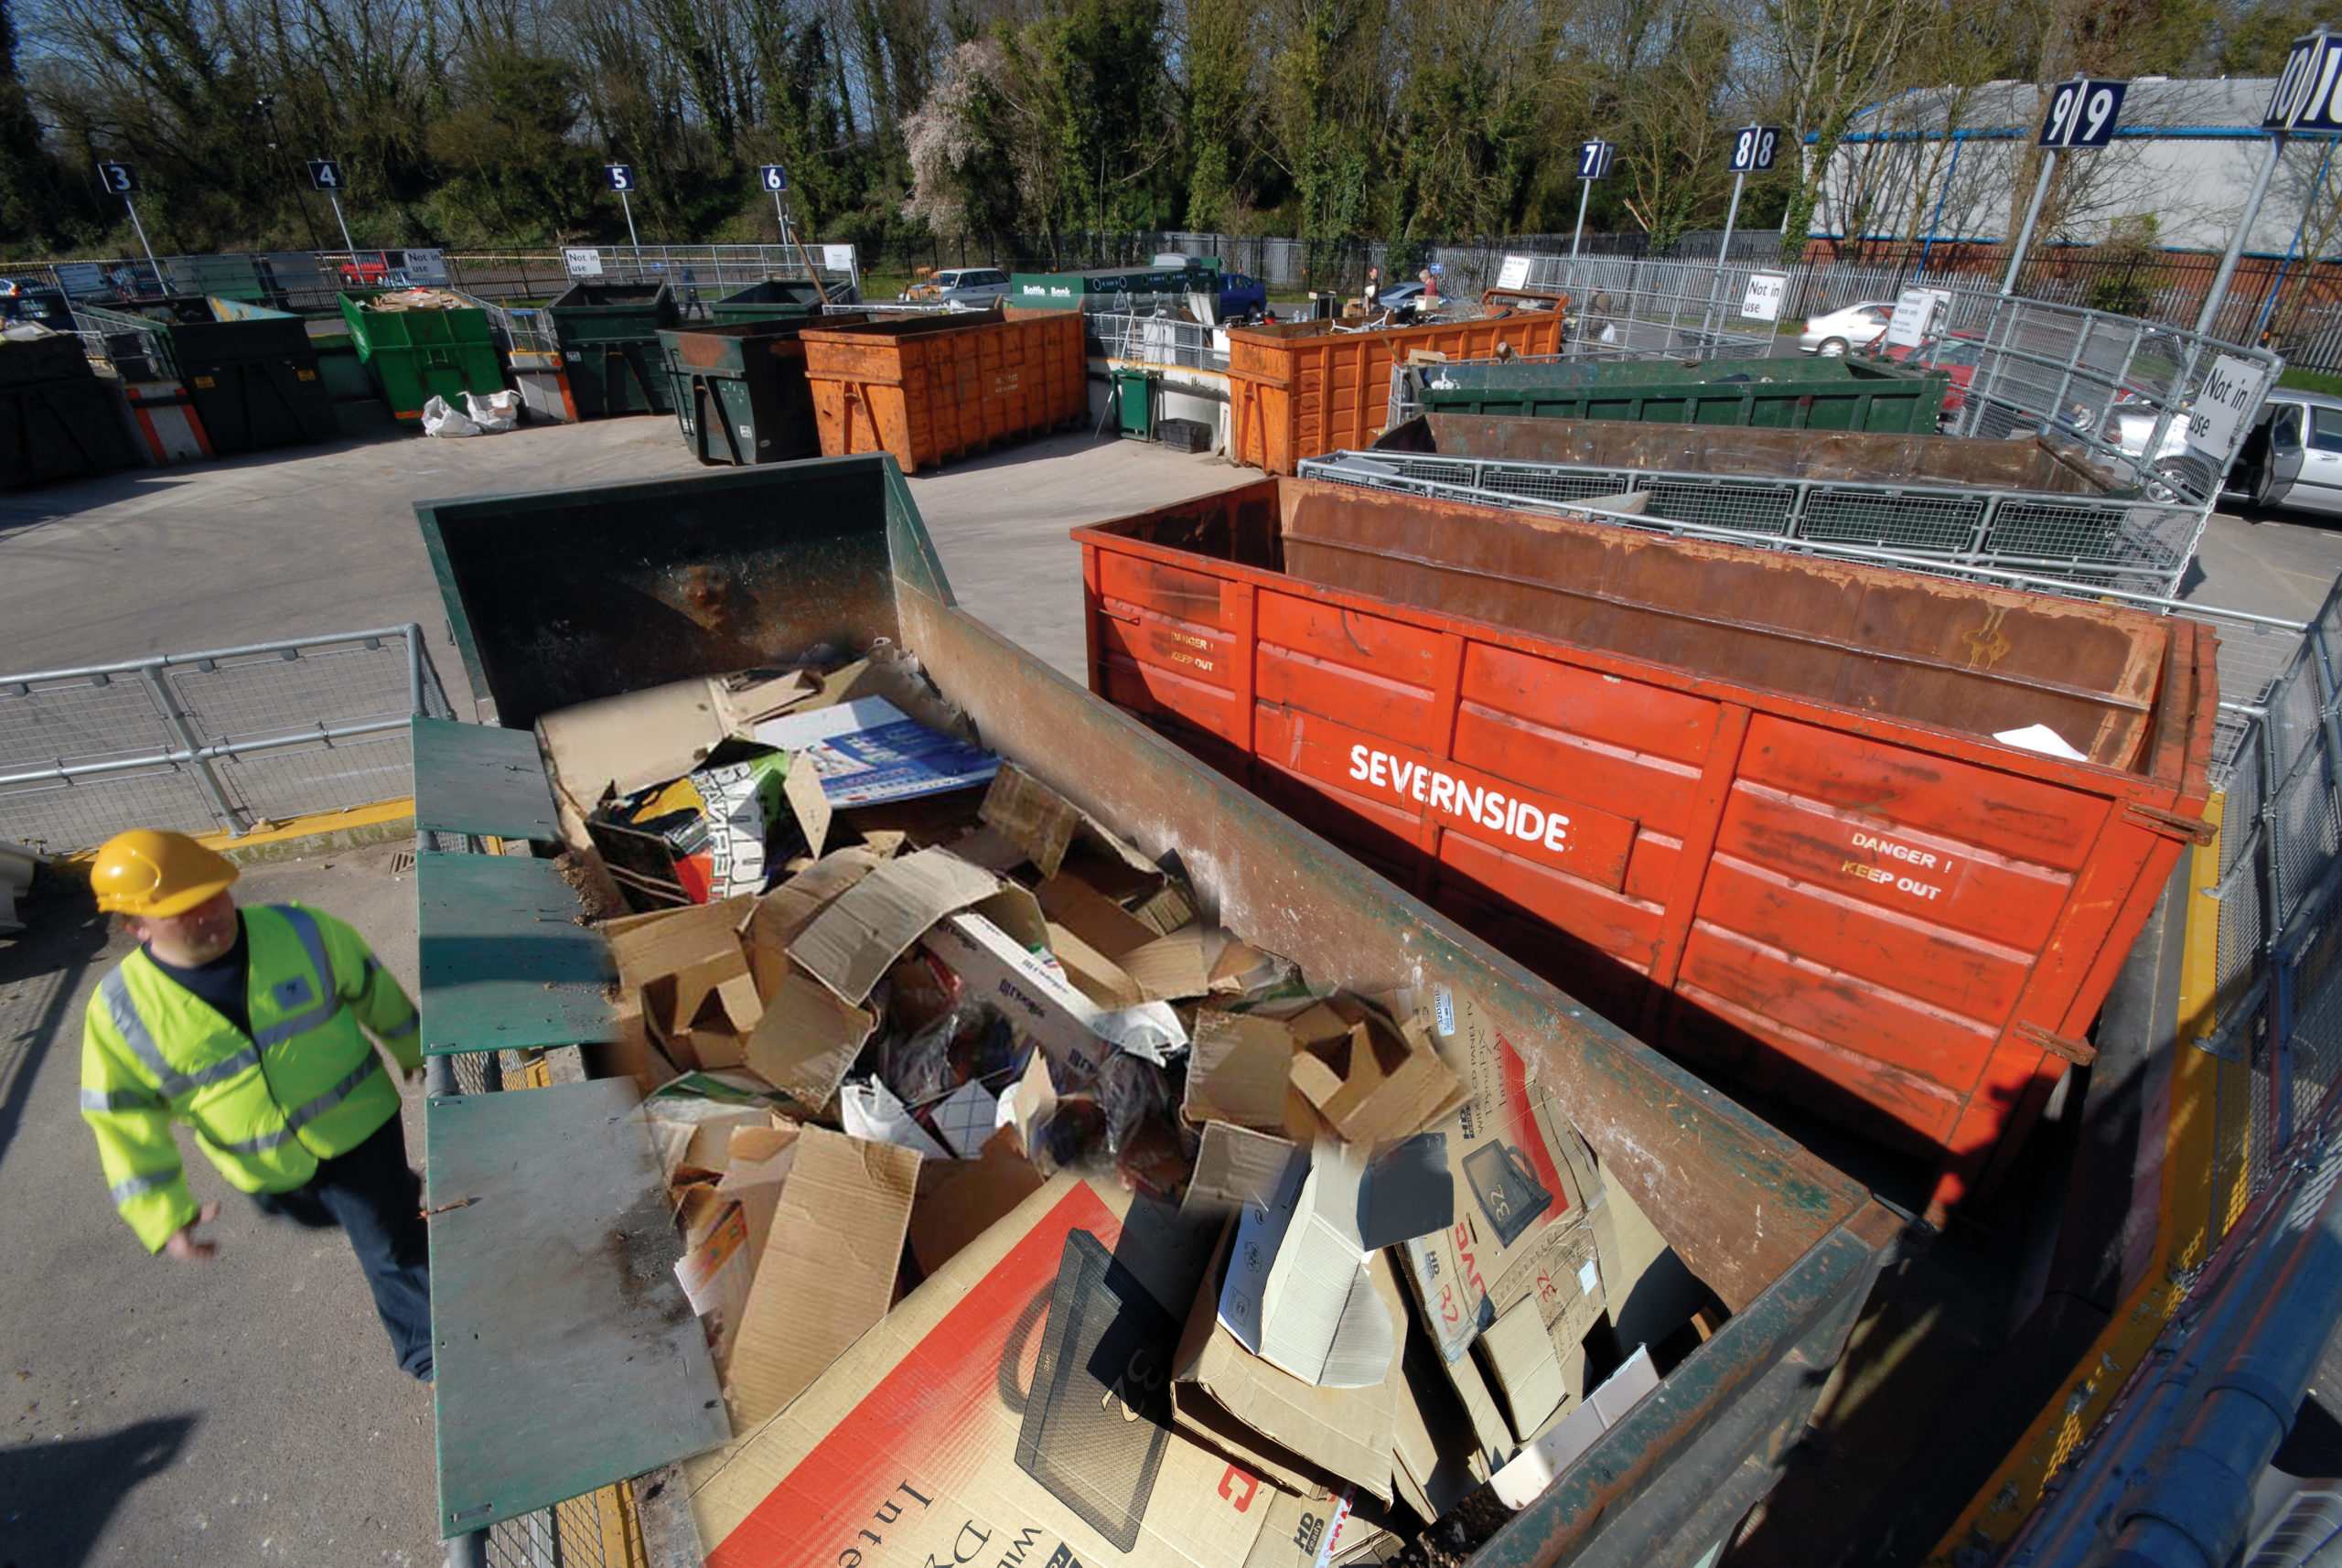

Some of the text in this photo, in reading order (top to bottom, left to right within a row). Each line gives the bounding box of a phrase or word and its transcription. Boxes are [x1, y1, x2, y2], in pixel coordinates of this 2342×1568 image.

[2047, 89, 2073, 140] 9
[2082, 89, 2113, 141] 9
[1583, 145, 1598, 174] 7
[1735, 132, 1751, 166] 8
[1758, 132, 1775, 166] 8
[110, 166, 131, 190] 3
[319, 165, 336, 187] 4
[612, 167, 627, 189] 5
[768, 168, 781, 189] 6
[409, 252, 429, 263] Not
[569, 252, 598, 263] Not in
[1023, 285, 1071, 298] Bottle Bank
[1748, 281, 1780, 297] Not in
[1744, 302, 1760, 314] use
[2203, 368, 2249, 411] Not in
[2189, 412, 2211, 438] use
[1195, 658, 1214, 671] OUT
[1349, 744, 1570, 853] SEVERNSIDE
[1851, 832, 1938, 869] DANGER
[1842, 860, 1942, 900] KEEP OUT
[1467, 1021, 1477, 1066] PANEL
[1429, 1250, 1440, 1276] HD
[1043, 1354, 1052, 1371] JVC
[1293, 1511, 1315, 1551] HD
[1305, 1520, 1324, 1554] ready
